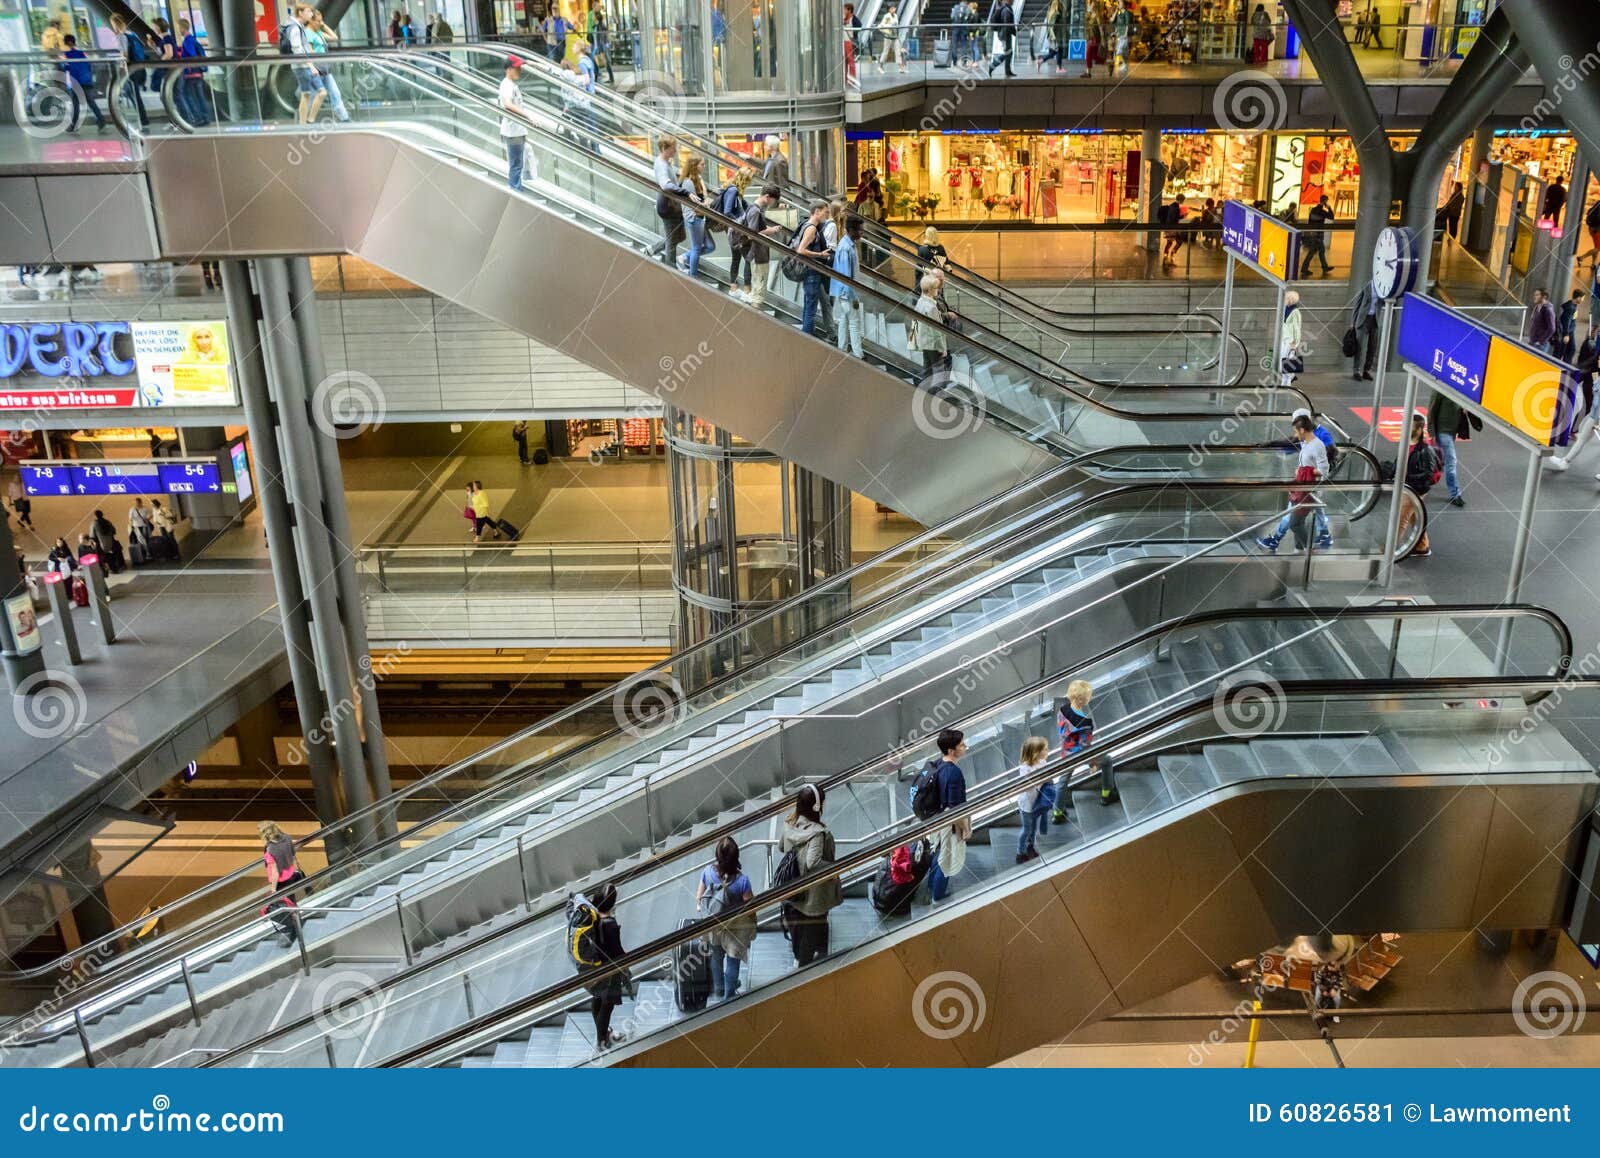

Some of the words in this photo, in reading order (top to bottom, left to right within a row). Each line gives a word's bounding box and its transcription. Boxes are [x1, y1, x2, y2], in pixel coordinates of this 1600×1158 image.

[31, 396, 55, 405] aus
[58, 391, 117, 405] wirksam
[34, 467, 53, 478] 7-8
[83, 466, 102, 477] 7-8
[185, 464, 204, 476] 5-6
